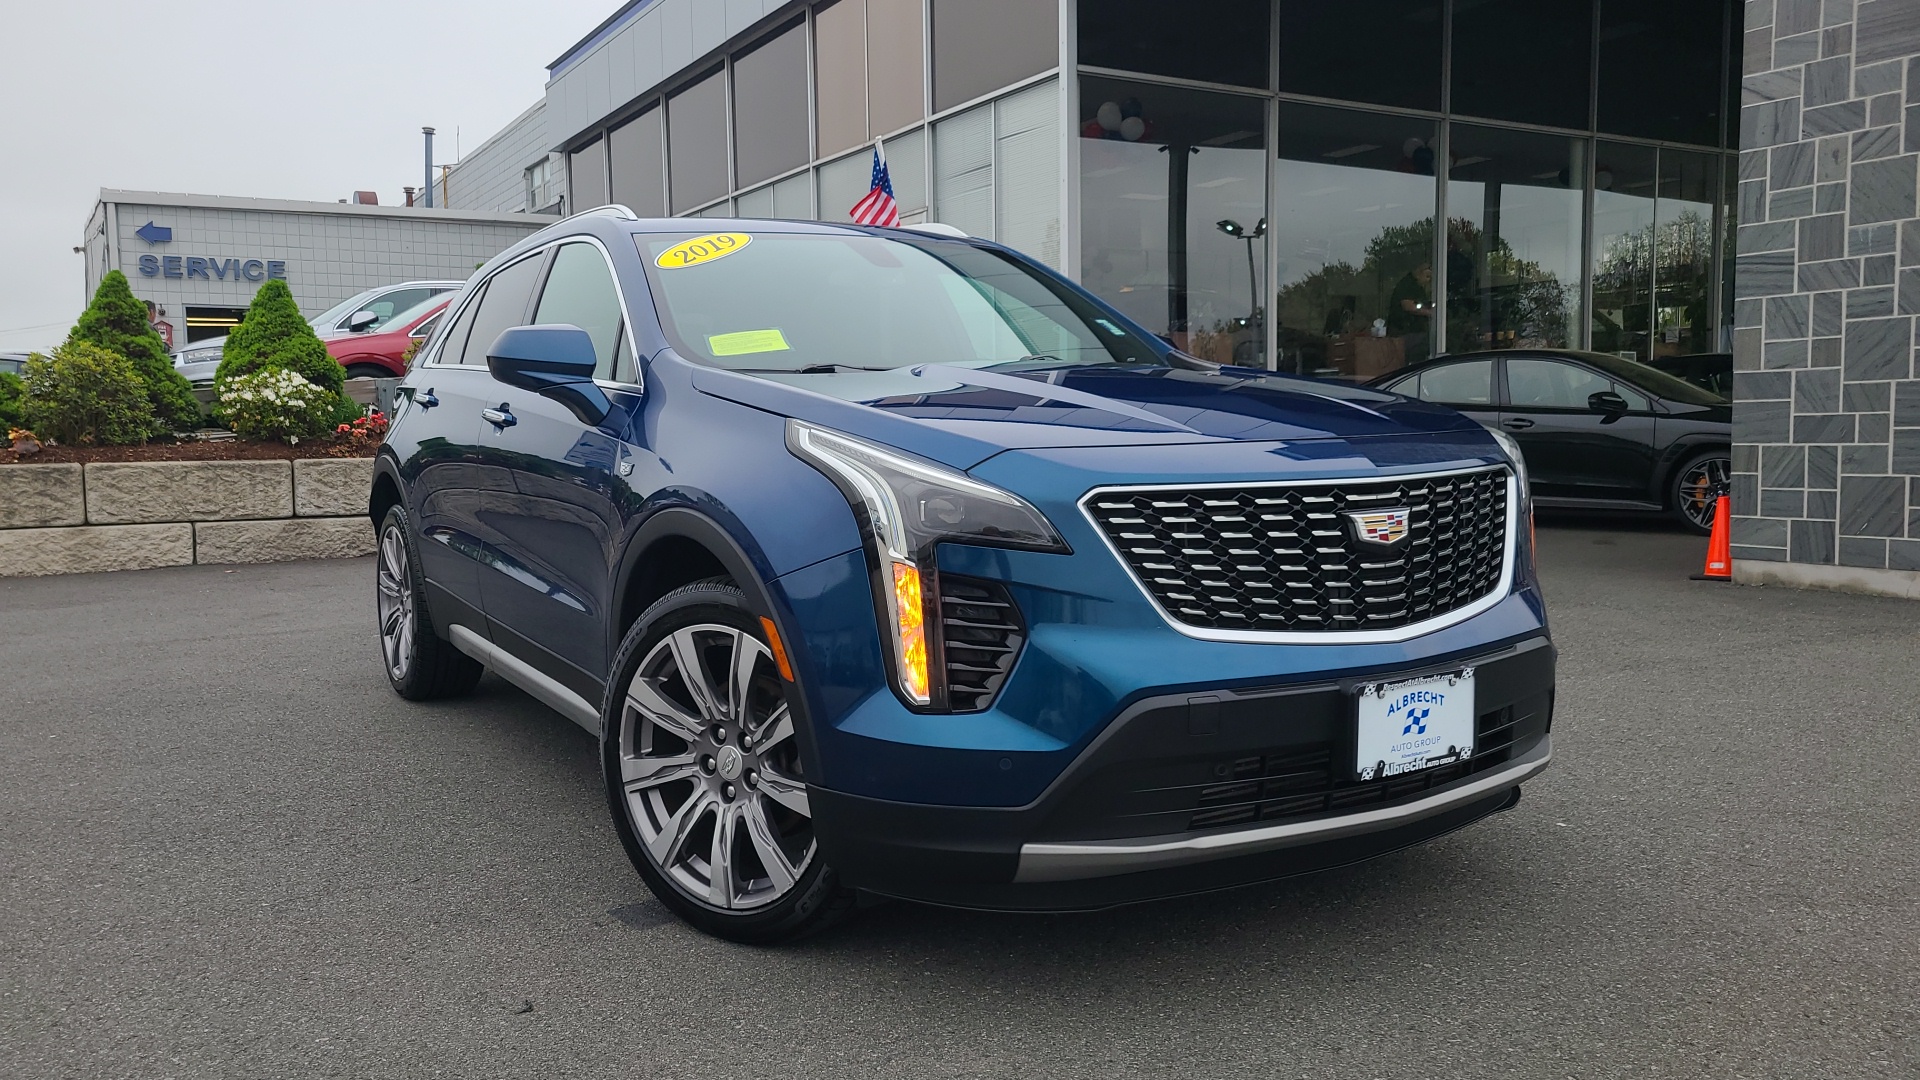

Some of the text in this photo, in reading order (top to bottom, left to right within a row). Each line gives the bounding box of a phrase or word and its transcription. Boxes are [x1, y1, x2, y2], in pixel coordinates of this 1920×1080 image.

[673, 235, 736, 264] 2019
[138, 254, 287, 281] SERVICE
[1386, 691, 1445, 717] ALBRECHT
[1390, 735, 1441, 753] AUTO GROUP
[1382, 756, 1456, 777] Albrecht AUTO GROUP
